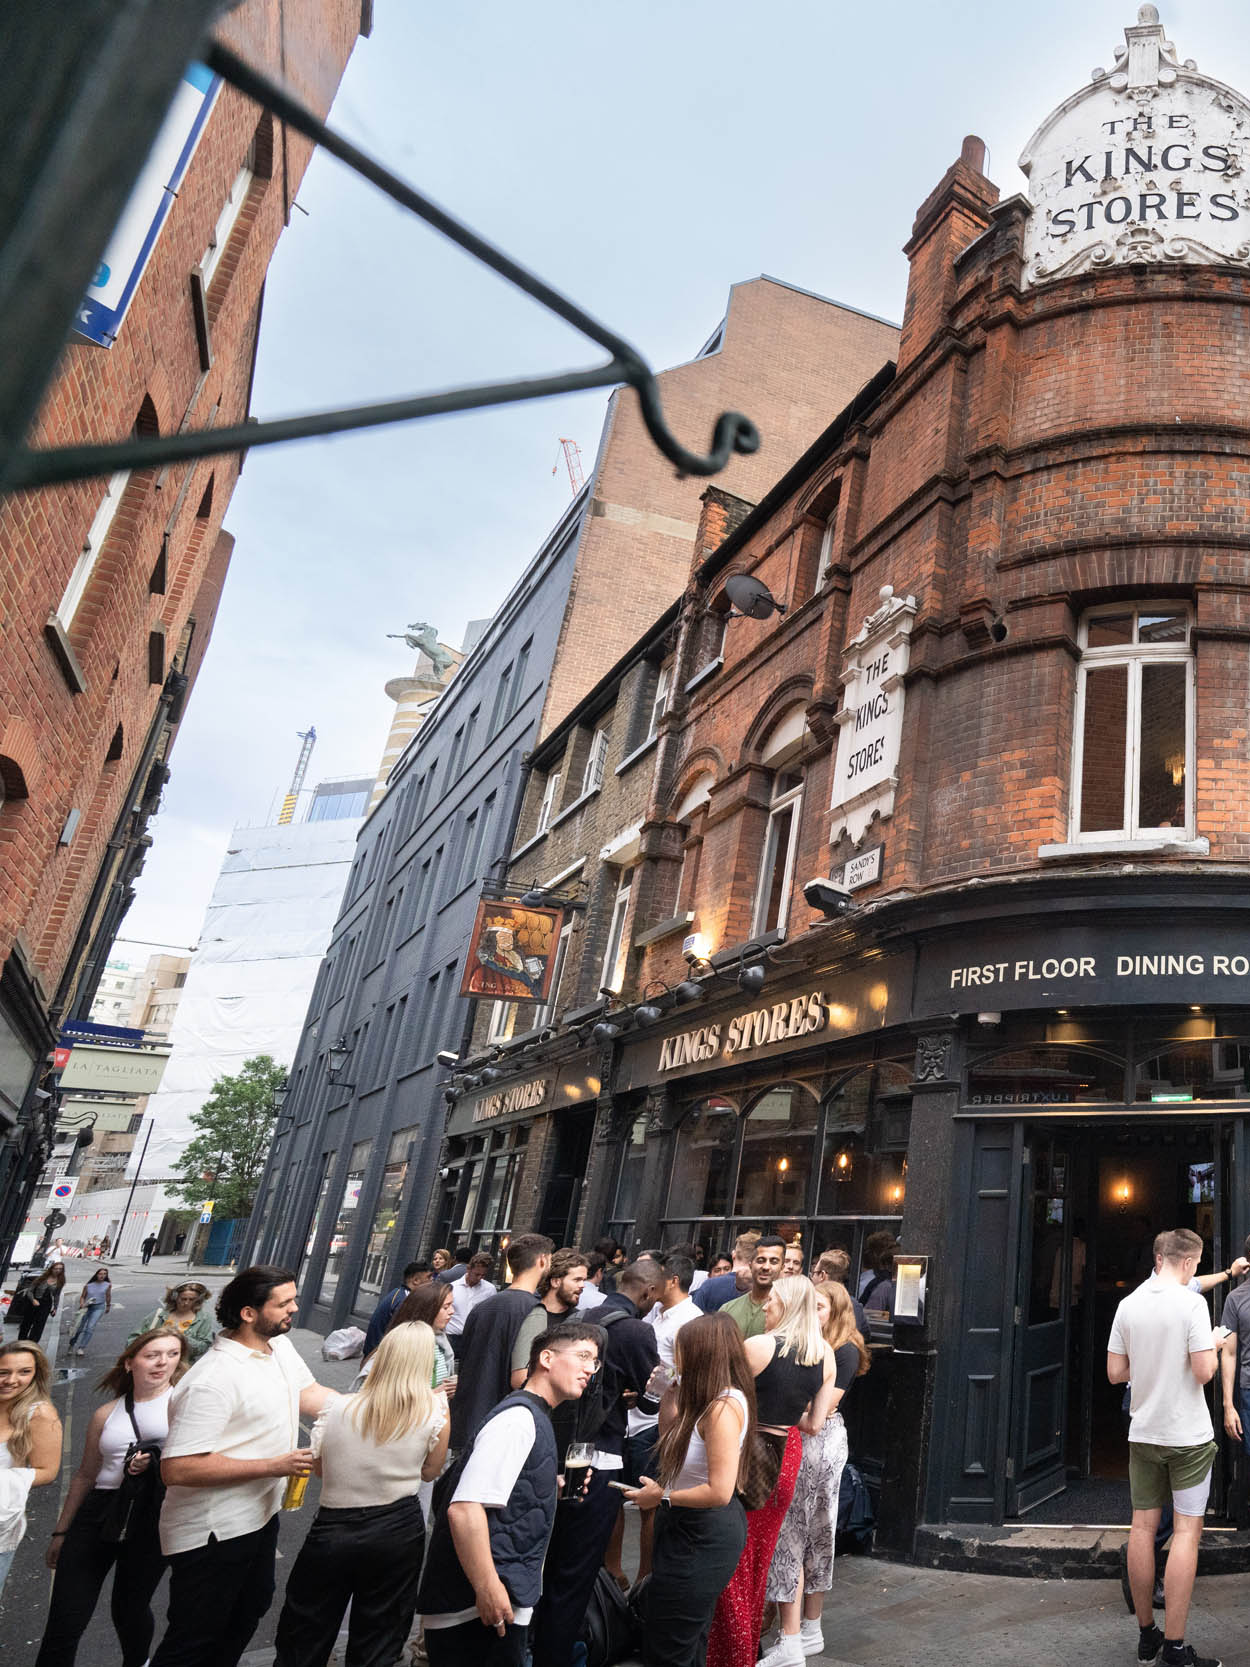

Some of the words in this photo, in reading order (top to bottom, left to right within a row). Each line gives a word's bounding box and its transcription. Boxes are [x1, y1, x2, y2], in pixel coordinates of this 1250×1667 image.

[1102, 114, 1191, 135] THE
[1063, 144, 1232, 188] KINGS
[1050, 192, 1240, 239] STORES
[866, 652, 890, 685] THE
[855, 691, 890, 733] KINGS
[849, 870, 864, 885] ROW
[850, 853, 876, 873] SANDY'S
[950, 963, 1009, 988] FIRST
[1014, 957, 1096, 981] FLOOR
[1116, 955, 1205, 976] DINING
[657, 1024, 721, 1072] KINGS
[726, 991, 824, 1053] STORES
[72, 1062, 88, 1070] LA
[95, 1064, 158, 1076] TAGLIATA
[472, 1093, 503, 1123] KINGS
[502, 1080, 545, 1114] STORES
